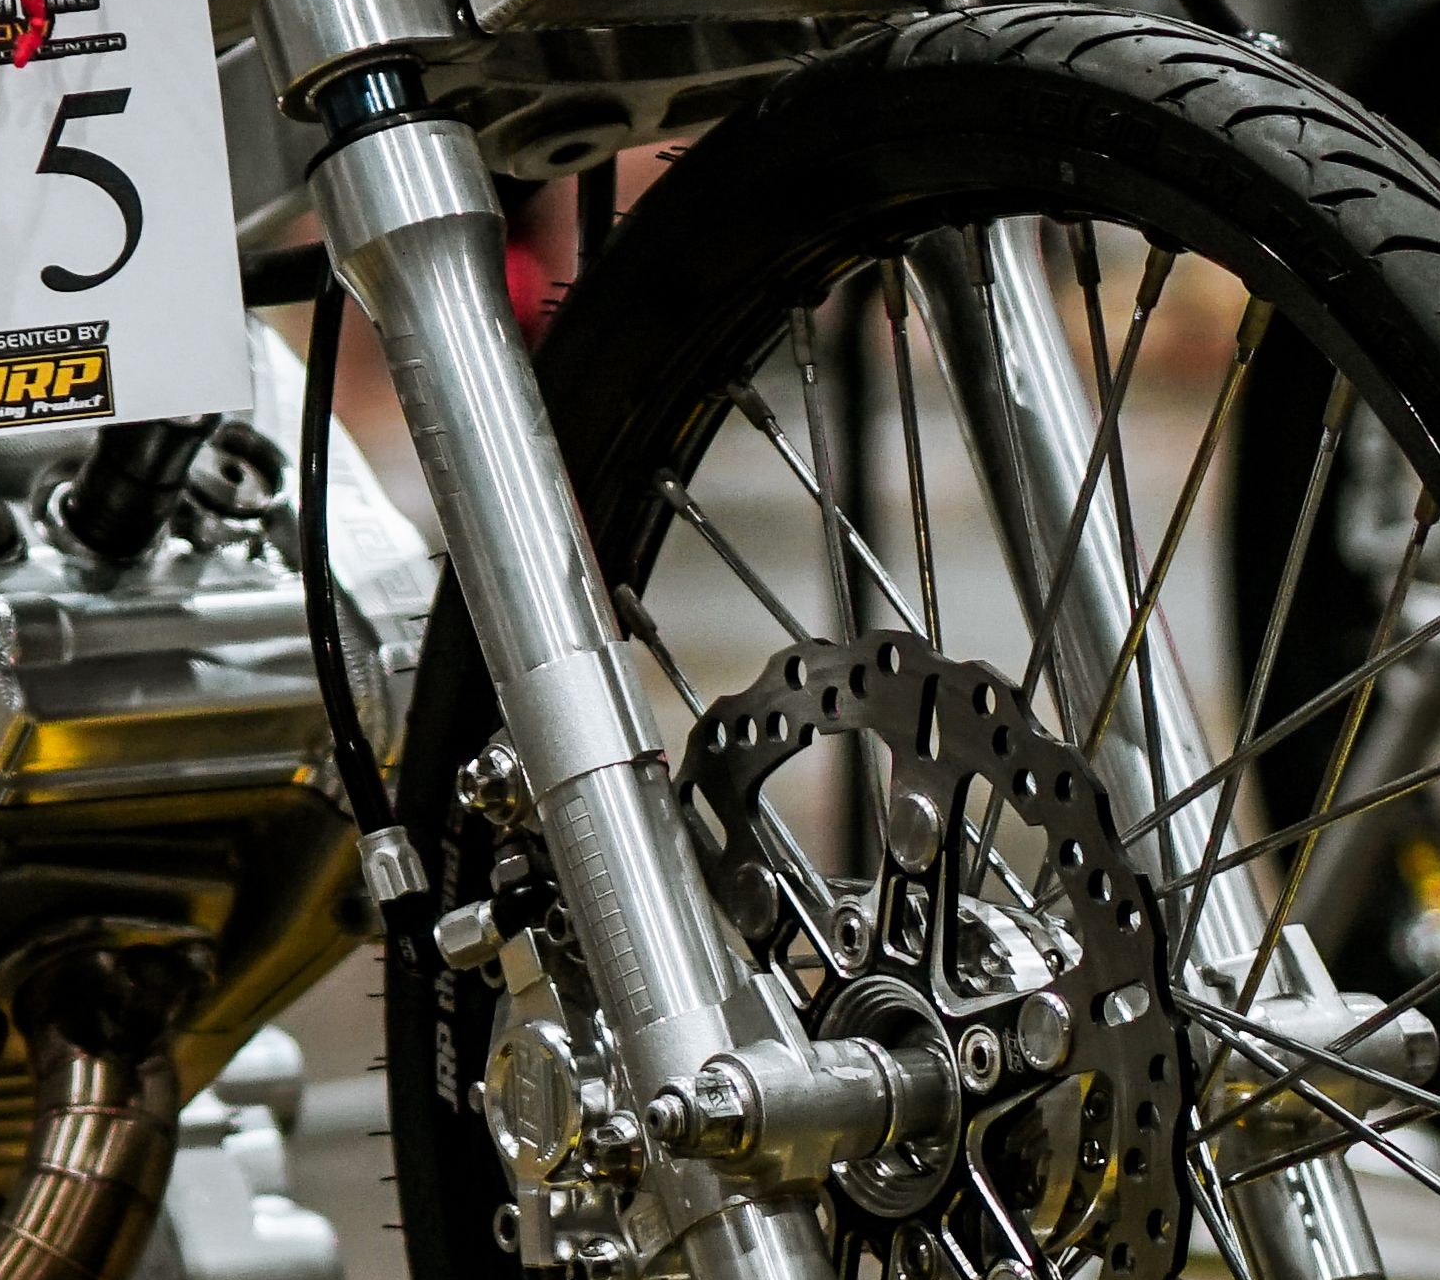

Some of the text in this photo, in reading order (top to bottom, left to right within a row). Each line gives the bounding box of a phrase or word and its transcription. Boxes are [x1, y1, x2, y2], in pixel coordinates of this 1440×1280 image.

[36, 36, 123, 55] CENTER
[77, 324, 103, 341] BY
[31, 393, 104, 414] Product
[434, 1019, 461, 1114] JRP
